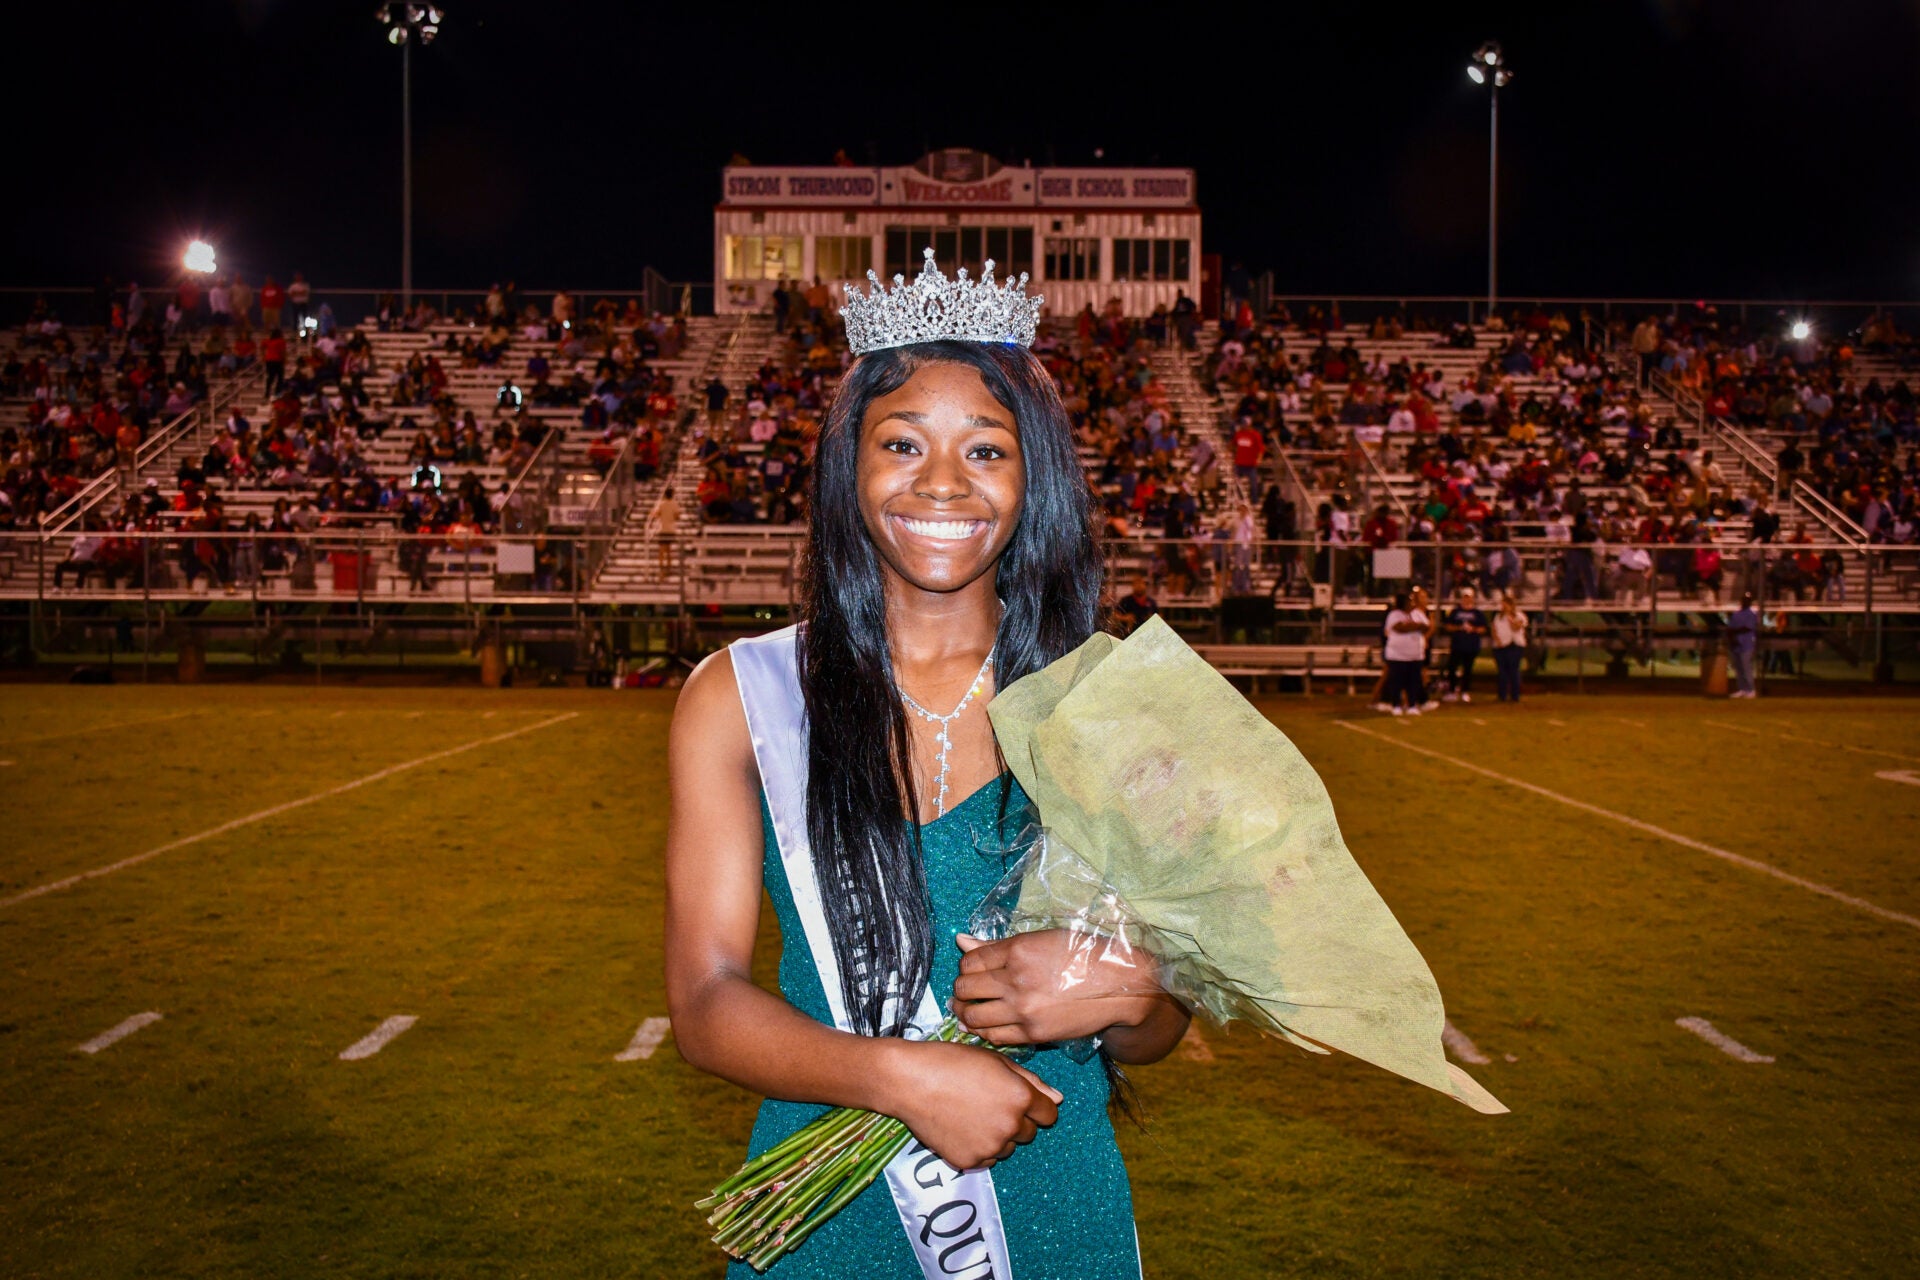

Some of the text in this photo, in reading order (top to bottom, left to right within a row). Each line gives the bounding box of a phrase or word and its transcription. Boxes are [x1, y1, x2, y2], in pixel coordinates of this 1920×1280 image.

[728, 176, 875, 196] STROM THURMOND
[902, 177, 1013, 202] WELCOME
[1041, 177, 1188, 198] HIGH SCHOOL STADIUM
